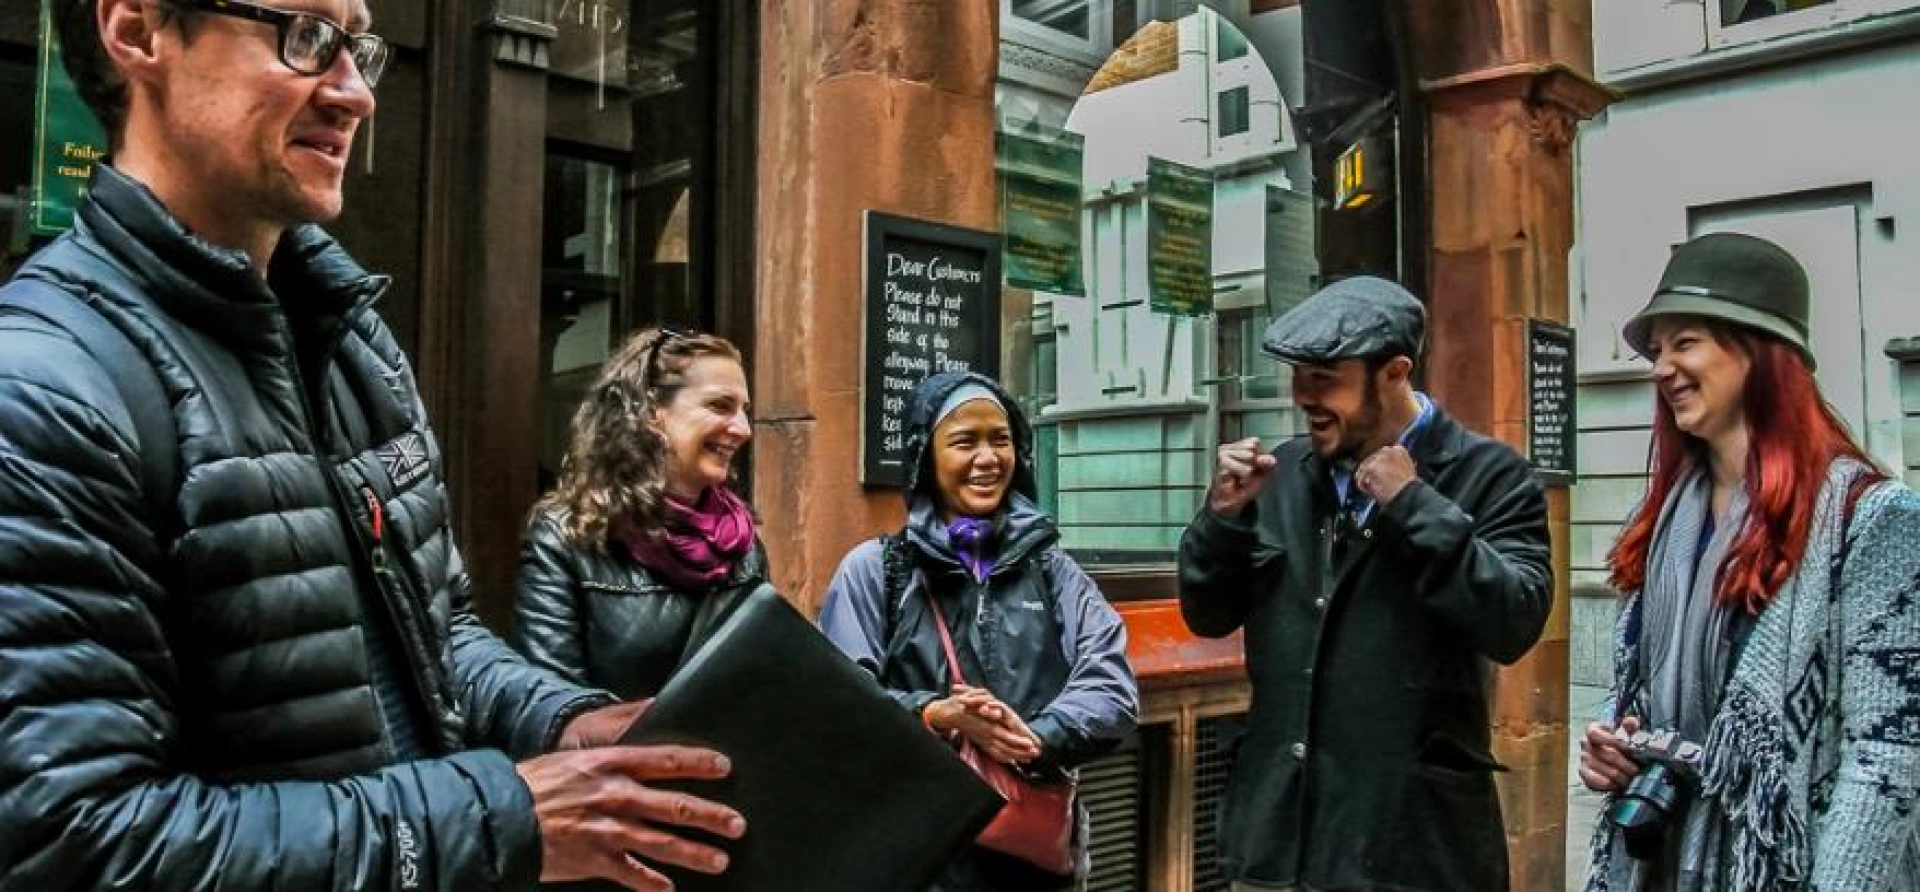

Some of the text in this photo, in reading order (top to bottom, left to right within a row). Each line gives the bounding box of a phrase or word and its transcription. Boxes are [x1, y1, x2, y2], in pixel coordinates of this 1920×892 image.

[887, 252, 926, 276] Dear
[927, 256, 981, 282] Customers
[884, 281, 963, 311] Please do not
[925, 311, 936, 326] in
[939, 309, 960, 328] this
[916, 333, 928, 353] of
[933, 332, 949, 349] the
